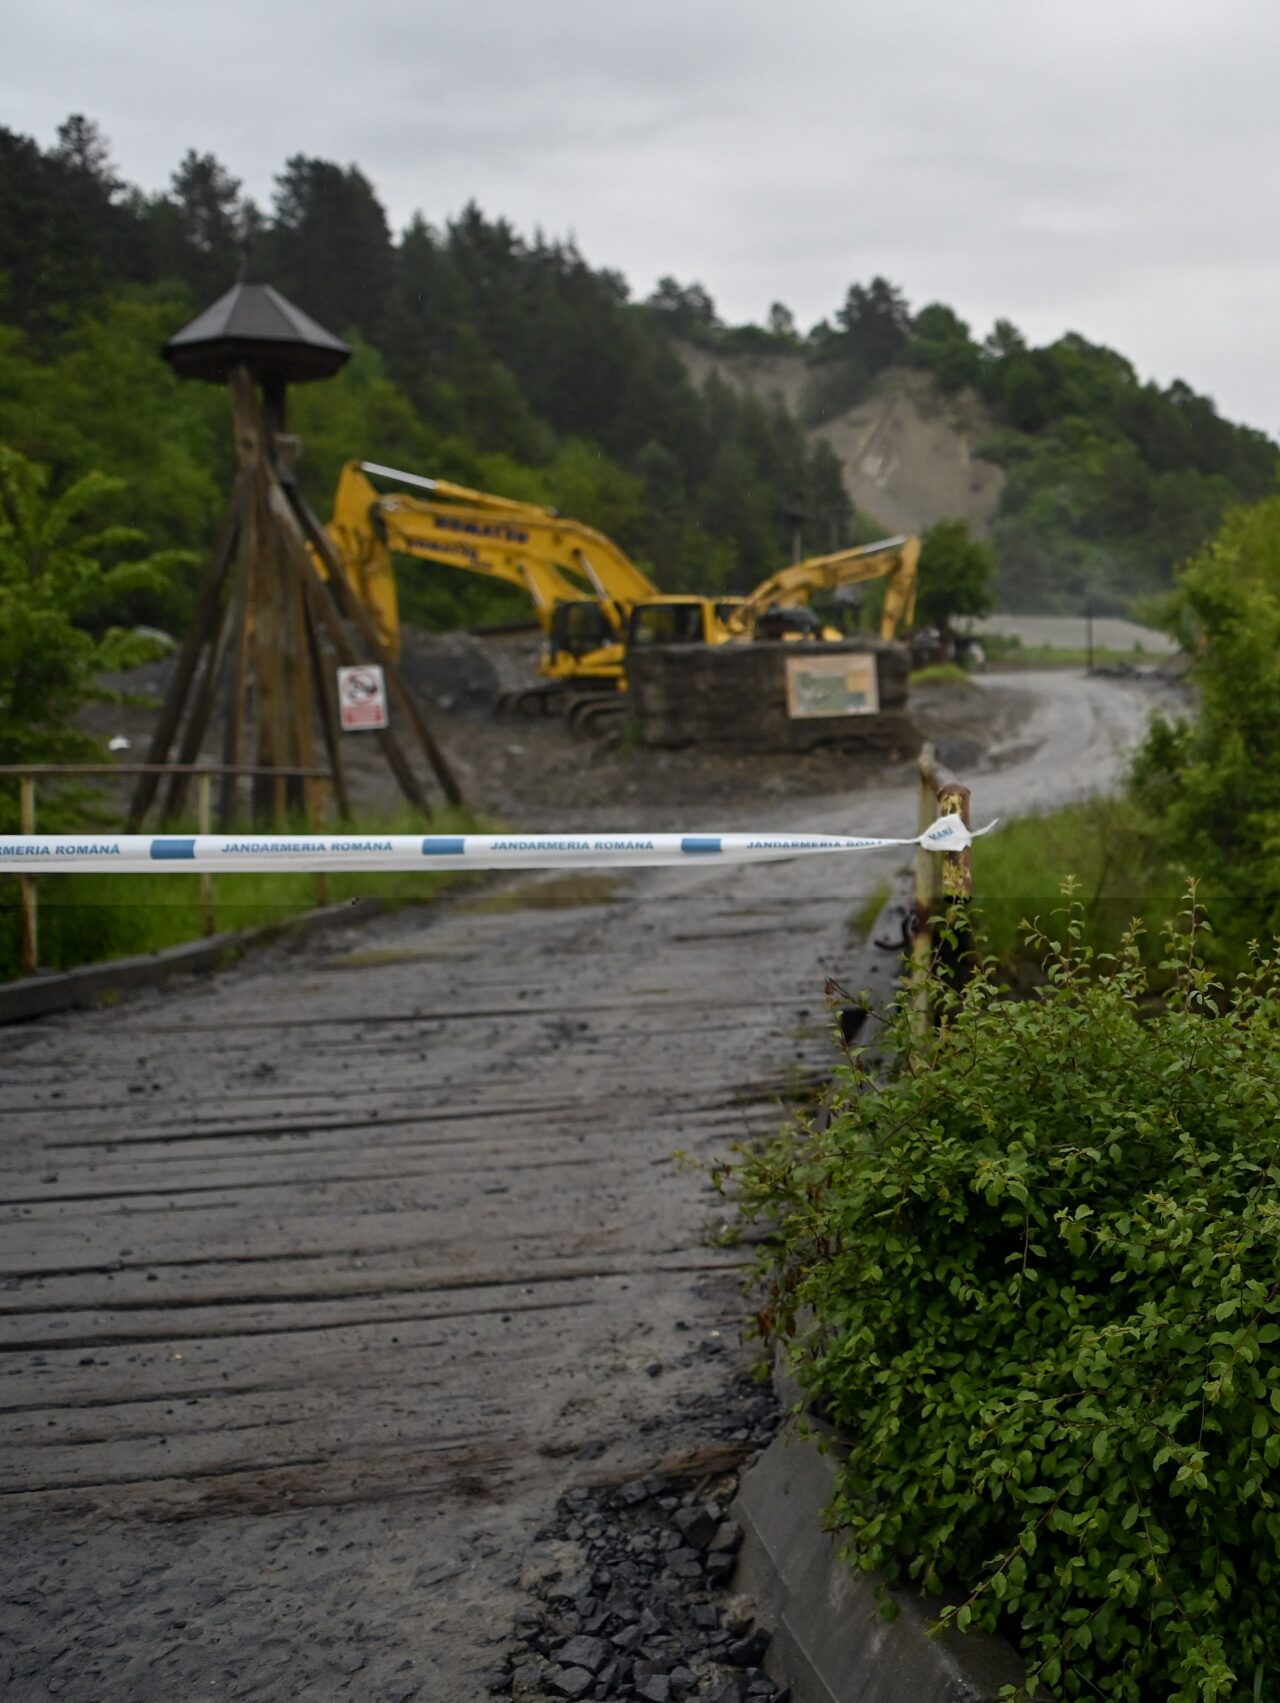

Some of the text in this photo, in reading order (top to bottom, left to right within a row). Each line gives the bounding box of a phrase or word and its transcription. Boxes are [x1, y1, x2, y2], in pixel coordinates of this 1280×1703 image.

[0, 845, 50, 856] MERIA
[222, 842, 326, 853] JANDARMERIA
[490, 841, 590, 850] JANDARMERIA
